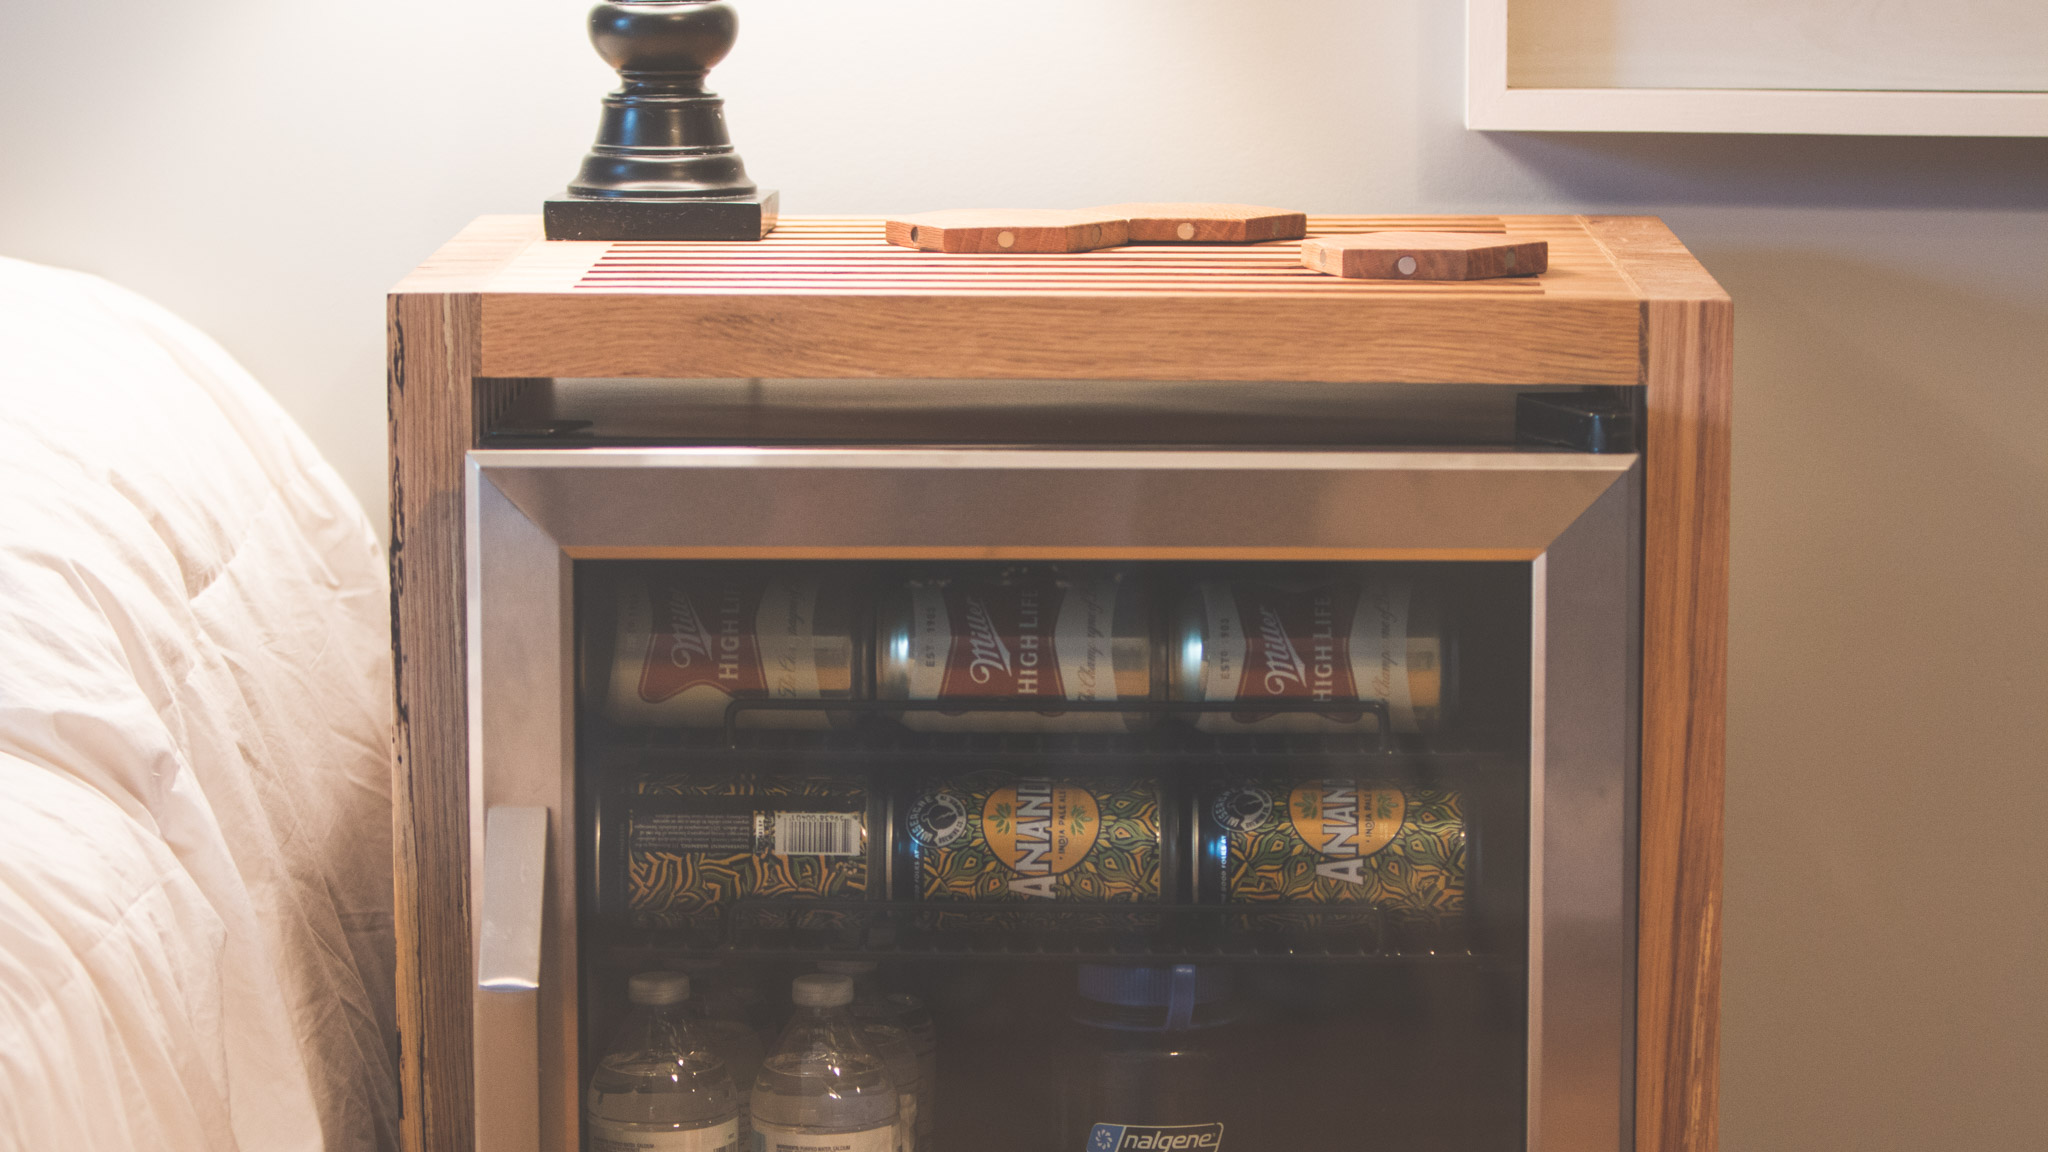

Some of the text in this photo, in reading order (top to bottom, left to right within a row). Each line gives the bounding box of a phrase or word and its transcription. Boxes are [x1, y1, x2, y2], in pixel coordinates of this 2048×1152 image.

[717, 619, 741, 681] HIGH
[966, 594, 1006, 684] Miller
[1017, 589, 1039, 695] HIGH LIFE
[1259, 603, 1300, 695] Miller
[1312, 597, 1334, 703] HIGH LIFE
[1058, 805, 1066, 826] PALE
[1058, 829, 1068, 855] INDIA
[1124, 1130, 1213, 1152] nalgene
